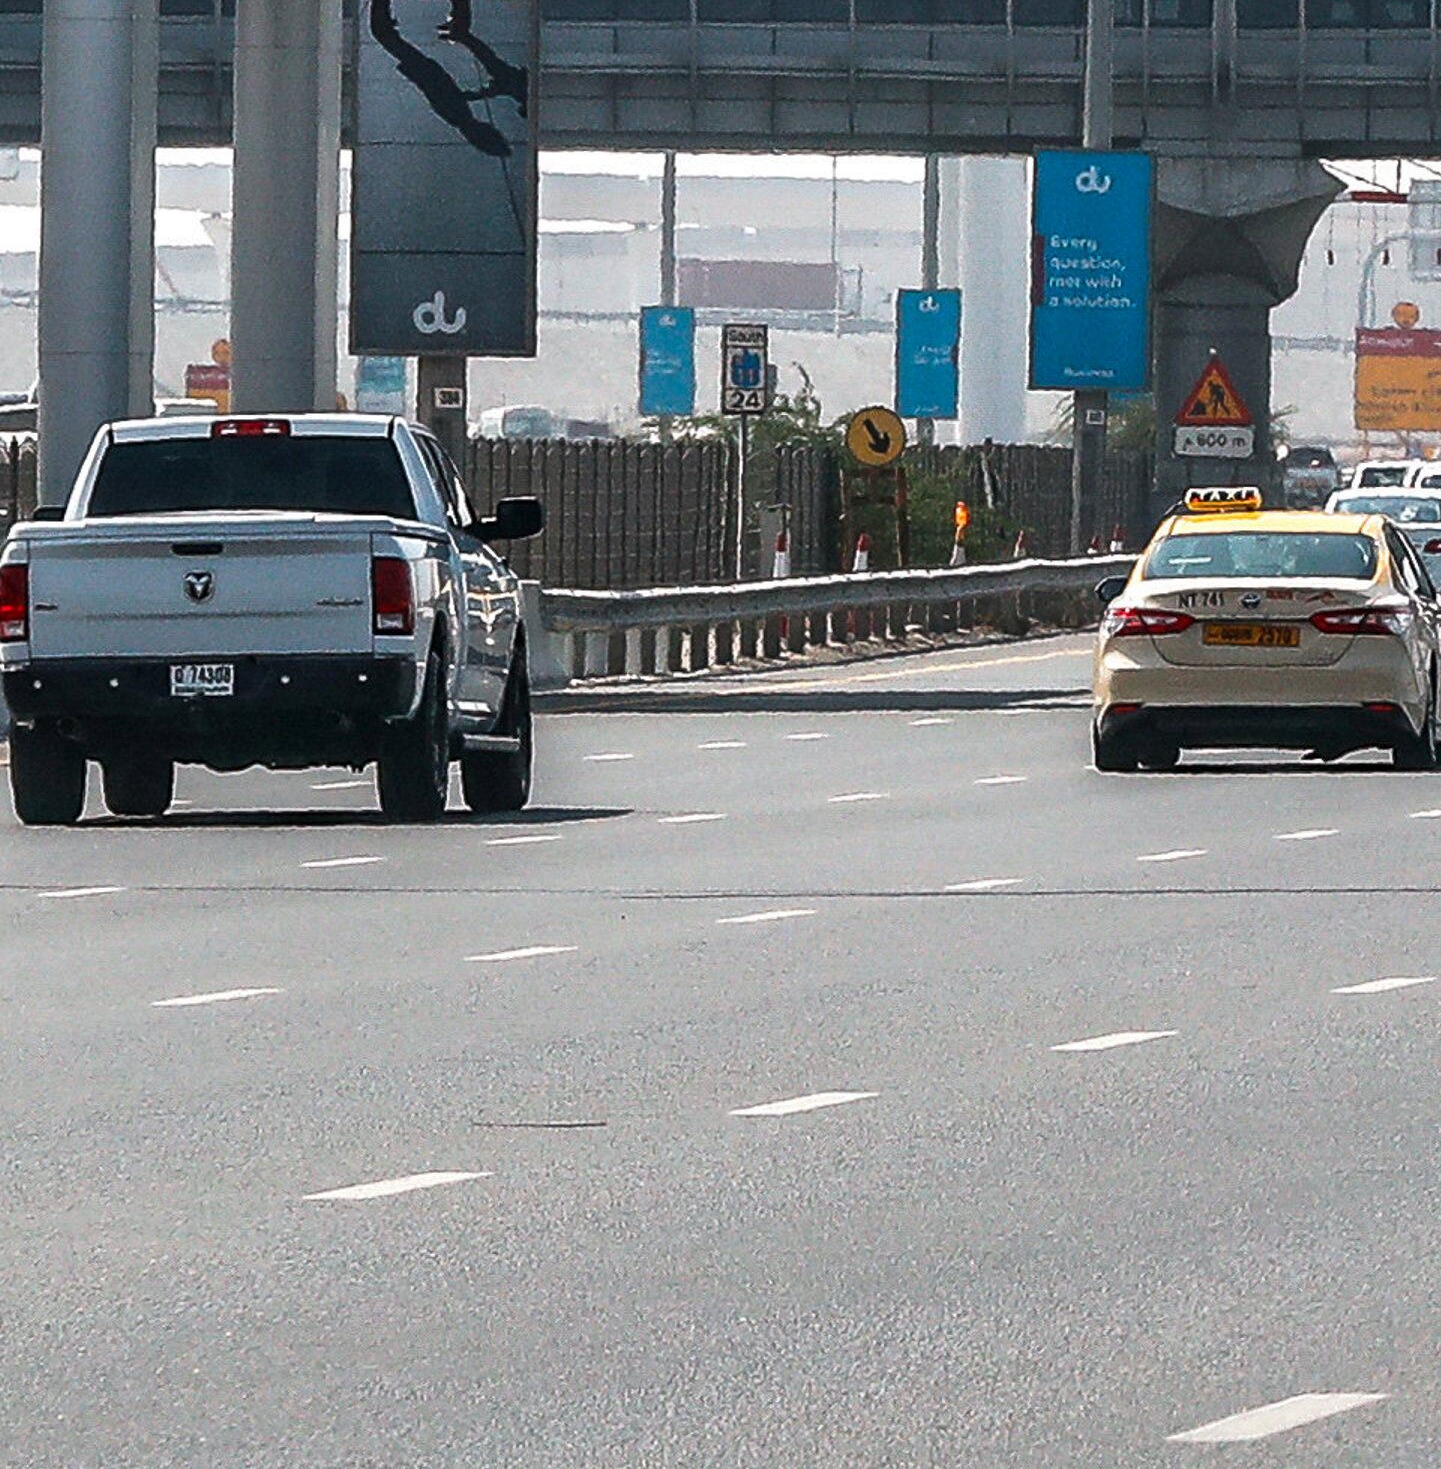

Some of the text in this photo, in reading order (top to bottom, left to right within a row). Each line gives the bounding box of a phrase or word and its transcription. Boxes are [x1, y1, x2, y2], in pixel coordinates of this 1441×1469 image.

[1075, 165, 1111, 193] du
[1050, 234, 1098, 252] Every
[413, 290, 467, 334] du
[730, 392, 761, 408] 24
[1232, 437, 1245, 447] m
